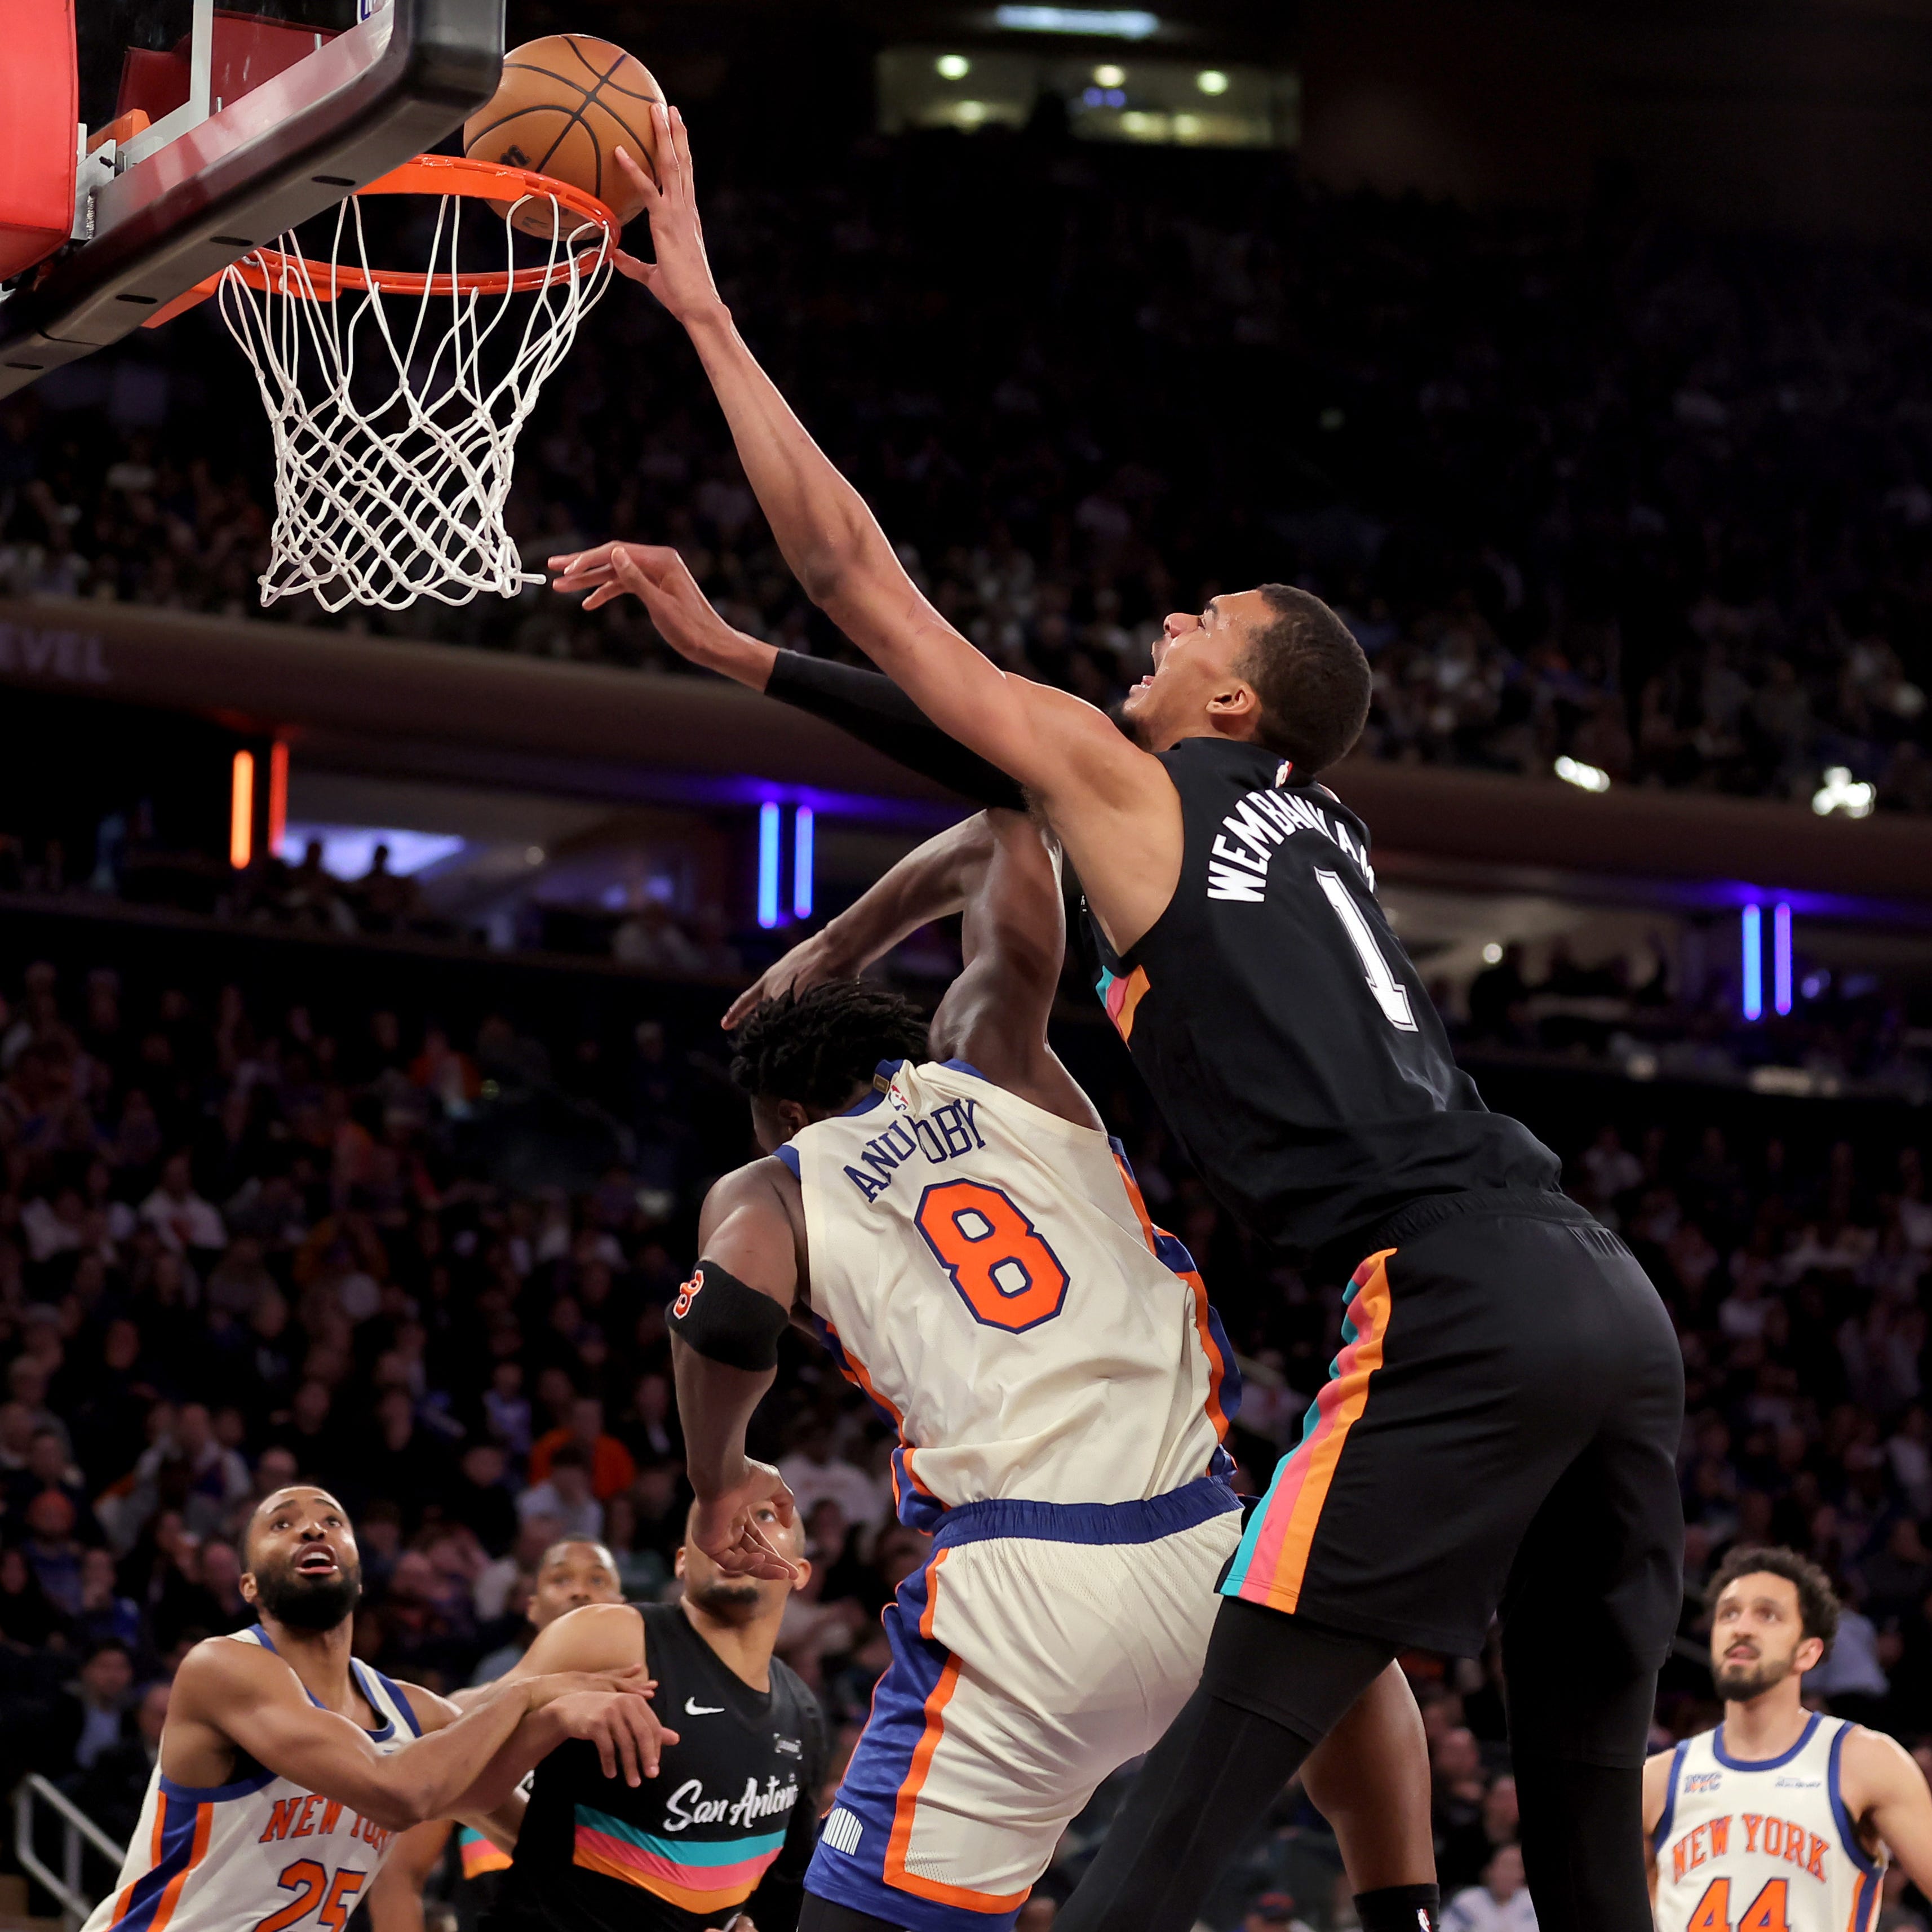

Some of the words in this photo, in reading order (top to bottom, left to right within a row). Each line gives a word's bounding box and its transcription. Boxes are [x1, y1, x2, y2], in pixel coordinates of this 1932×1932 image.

[1207, 789, 1379, 902] WEMBANYAM
[1313, 866, 1419, 1032] 1
[843, 1098, 986, 1203] ANUOBY
[914, 1177, 1071, 1335] 8
[258, 1794, 343, 1843] NEW
[662, 1779, 729, 1832] San
[1672, 1815, 1732, 1885] NEW
[1742, 1813, 1831, 1883] YORK
[252, 1858, 368, 1932] 25
[1686, 1876, 1790, 1932] 44
